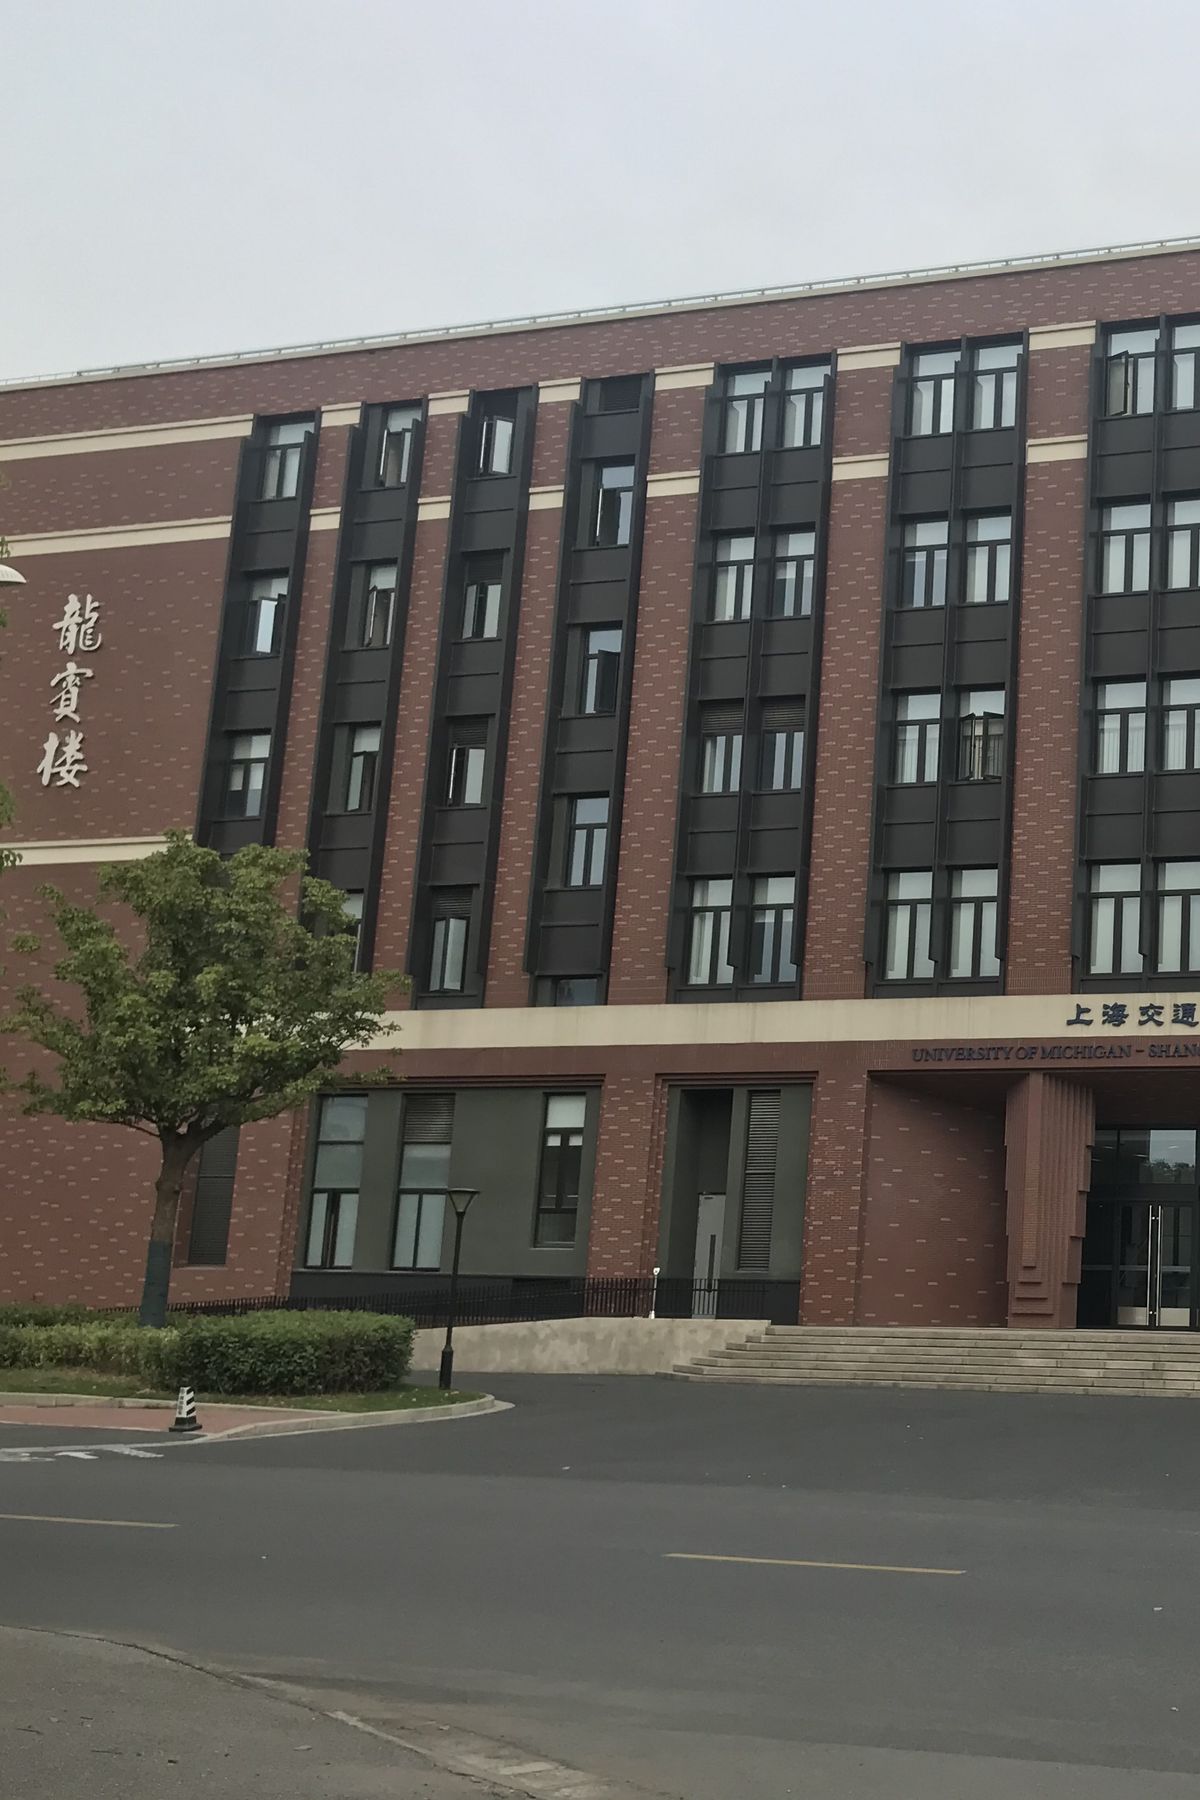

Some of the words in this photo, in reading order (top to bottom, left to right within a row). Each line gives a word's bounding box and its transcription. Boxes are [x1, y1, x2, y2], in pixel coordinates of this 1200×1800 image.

[912, 1047, 1012, 1062] UNIVERSITY
[1015, 1046, 1039, 1061] OF
[1040, 1044, 1132, 1060] MICHIGAN
